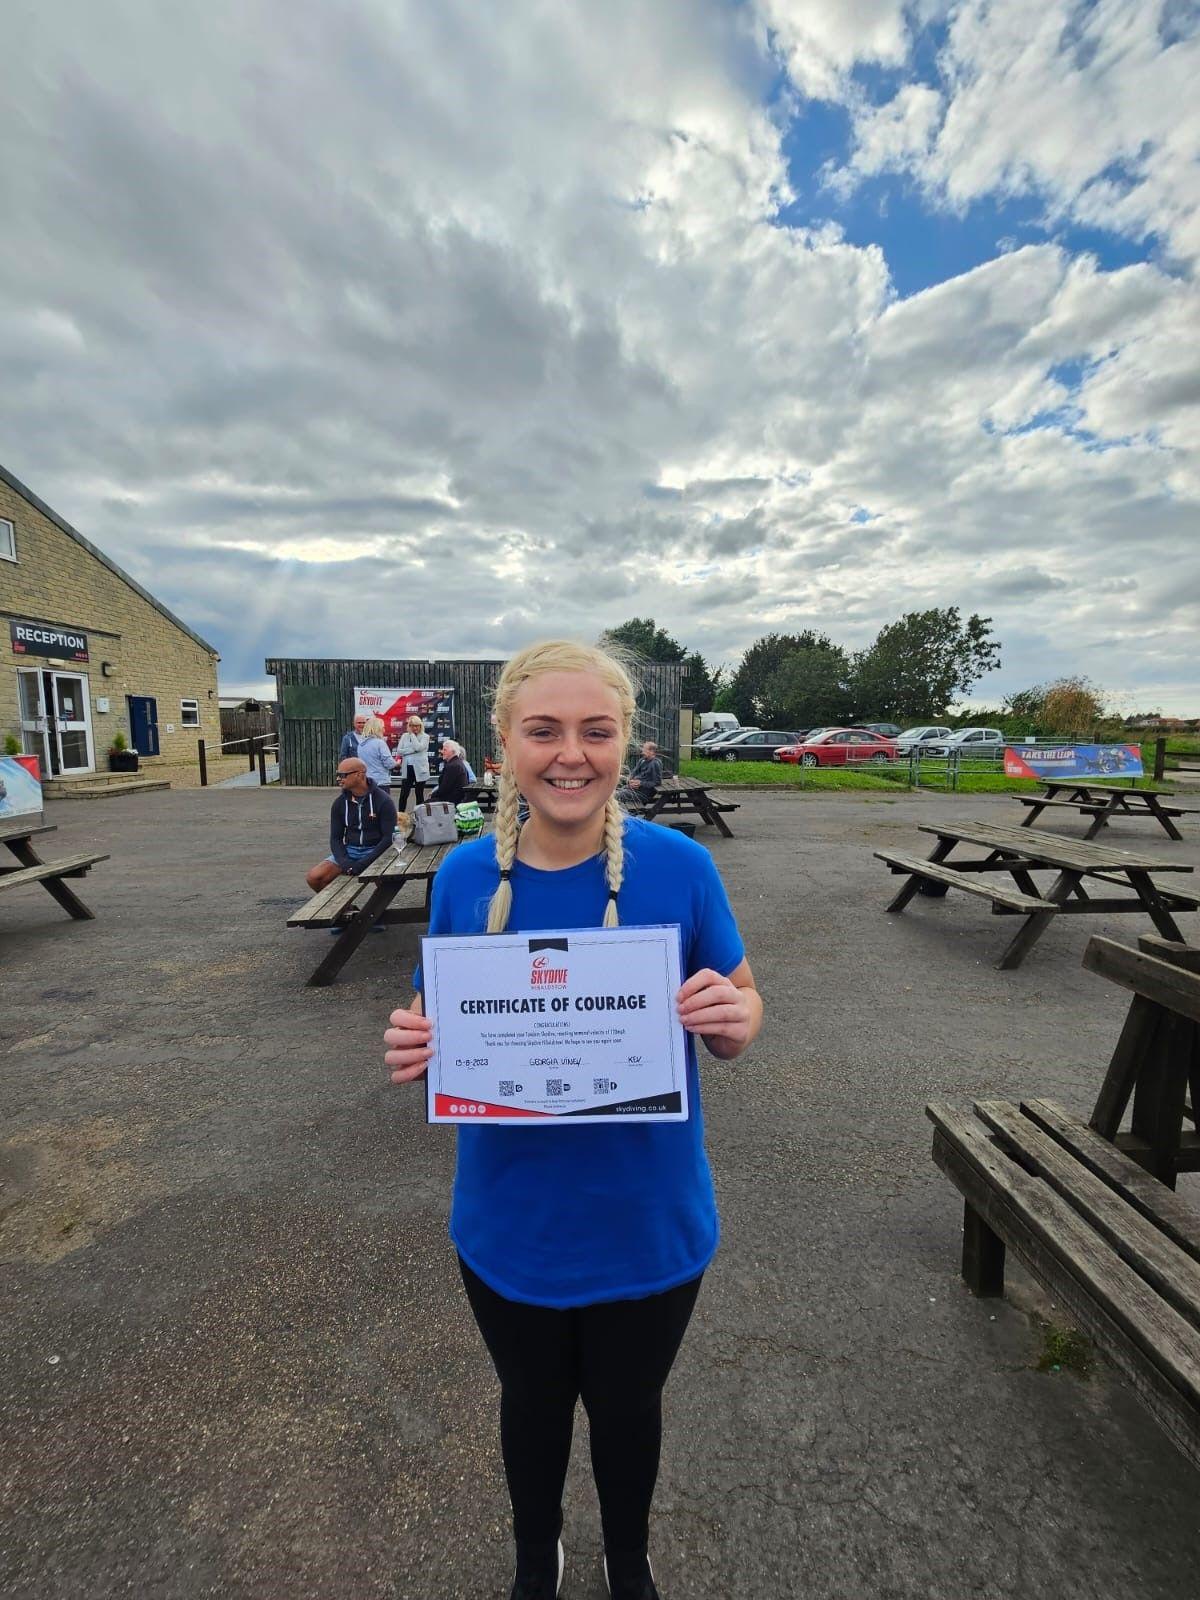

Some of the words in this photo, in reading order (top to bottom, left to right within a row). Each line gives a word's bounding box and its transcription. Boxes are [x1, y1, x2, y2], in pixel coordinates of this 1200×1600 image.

[15, 626, 85, 649] RECEPTION
[1021, 749, 1042, 760] TAKE
[1042, 749, 1056, 759] THE
[530, 968, 569, 985] SKYDIVE
[460, 998, 546, 1015] CERTIFICATE
[551, 997, 570, 1012] OF
[574, 994, 647, 1011] COURAGE
[529, 1057, 559, 1066] GEORGIA
[627, 1055, 642, 1063] KEV
[615, 1105, 667, 1113] skydiving.co.uk
